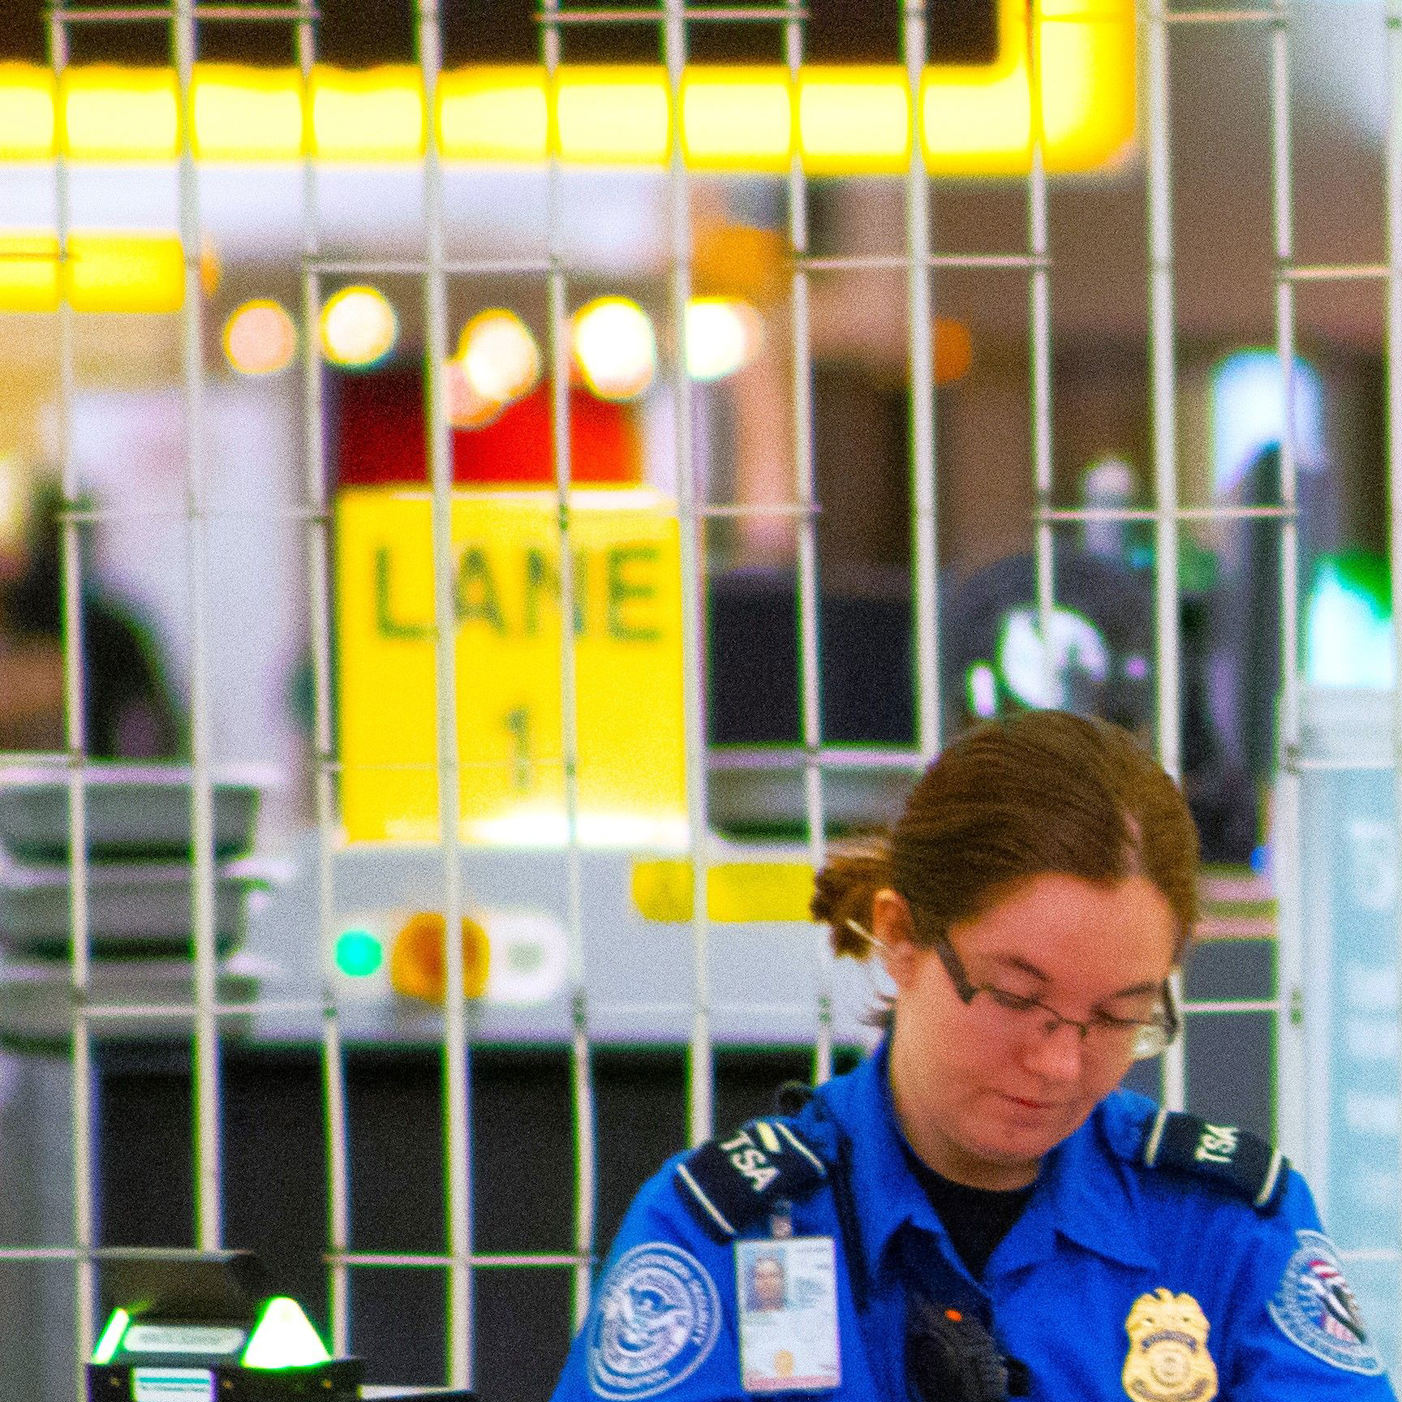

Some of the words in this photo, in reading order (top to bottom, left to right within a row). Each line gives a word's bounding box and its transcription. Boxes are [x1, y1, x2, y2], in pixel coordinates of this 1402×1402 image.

[373, 545, 663, 642] LANE
[503, 704, 533, 790] 1
[720, 1132, 782, 1193] TSA
[1195, 1123, 1239, 1164] TSA
